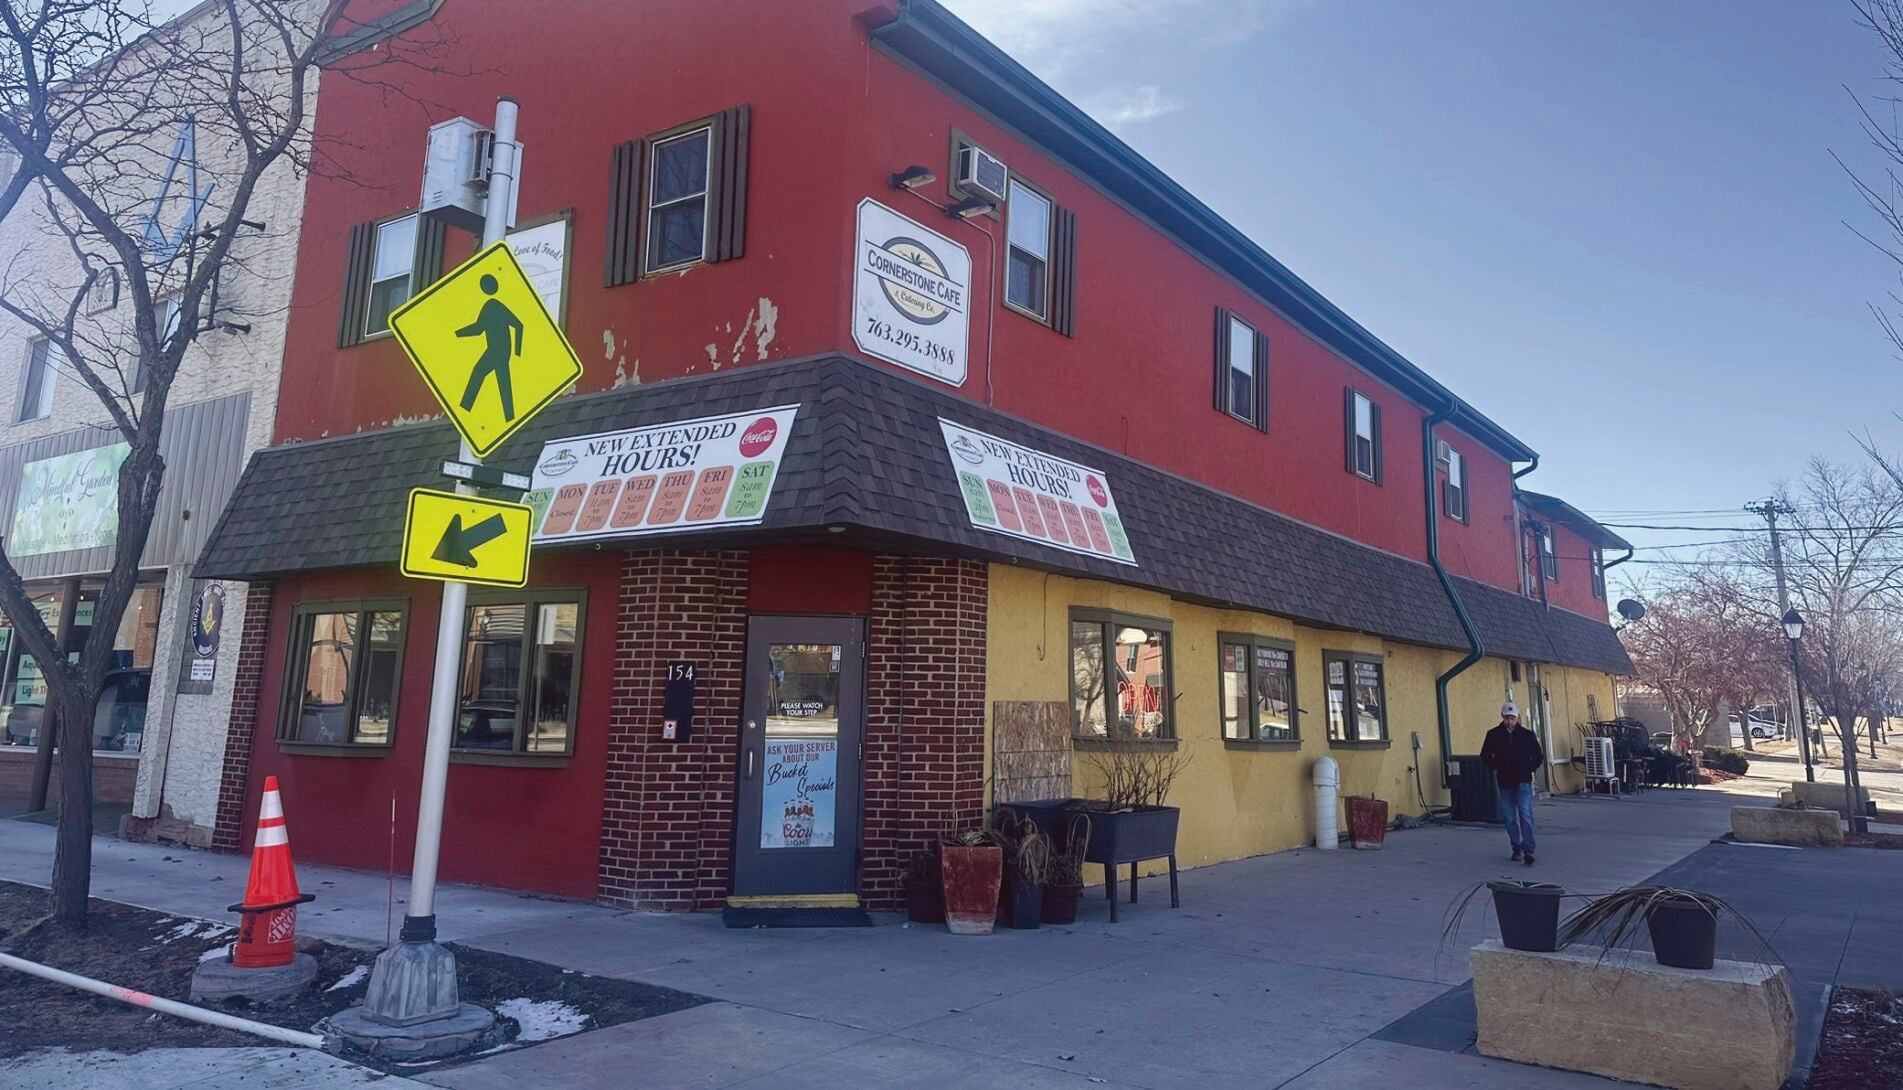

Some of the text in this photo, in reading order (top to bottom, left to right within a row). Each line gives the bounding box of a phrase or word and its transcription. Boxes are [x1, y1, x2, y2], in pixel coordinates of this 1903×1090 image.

[531, 241, 542, 256] of
[867, 249, 961, 306] CORNERSTONE CAFE
[901, 293, 925, 311] Catering
[867, 317, 956, 366] 763.295.3888
[584, 421, 737, 458] NEW EXTENDED
[600, 443, 702, 477] HOURS!
[980, 439, 1013, 462] NEW
[1013, 450, 1081, 483] EXTENDED
[704, 470, 728, 483] FRI
[741, 464, 770, 479] SAT
[78, 457, 113, 502] Garden
[625, 478, 656, 491] WED
[664, 473, 692, 487] THU
[962, 475, 983, 489] SUN
[1006, 462, 1073, 499] HOURS!
[559, 487, 585, 500] MON
[594, 482, 618, 495] TUE
[987, 480, 1011, 497] MON
[528, 491, 549, 503] SUN
[695, 504, 716, 517] 7pm
[735, 500, 756, 514] 7pm
[668, 664, 694, 681] 154
[1117, 681, 1159, 713] OPEN
[802, 702, 824, 710] WATCH
[767, 742, 836, 755] ASK YOUR SERVER
[782, 753, 820, 763] ABOUT OUR
[766, 762, 809, 786] Bucket
[796, 776, 835, 799] Specials
